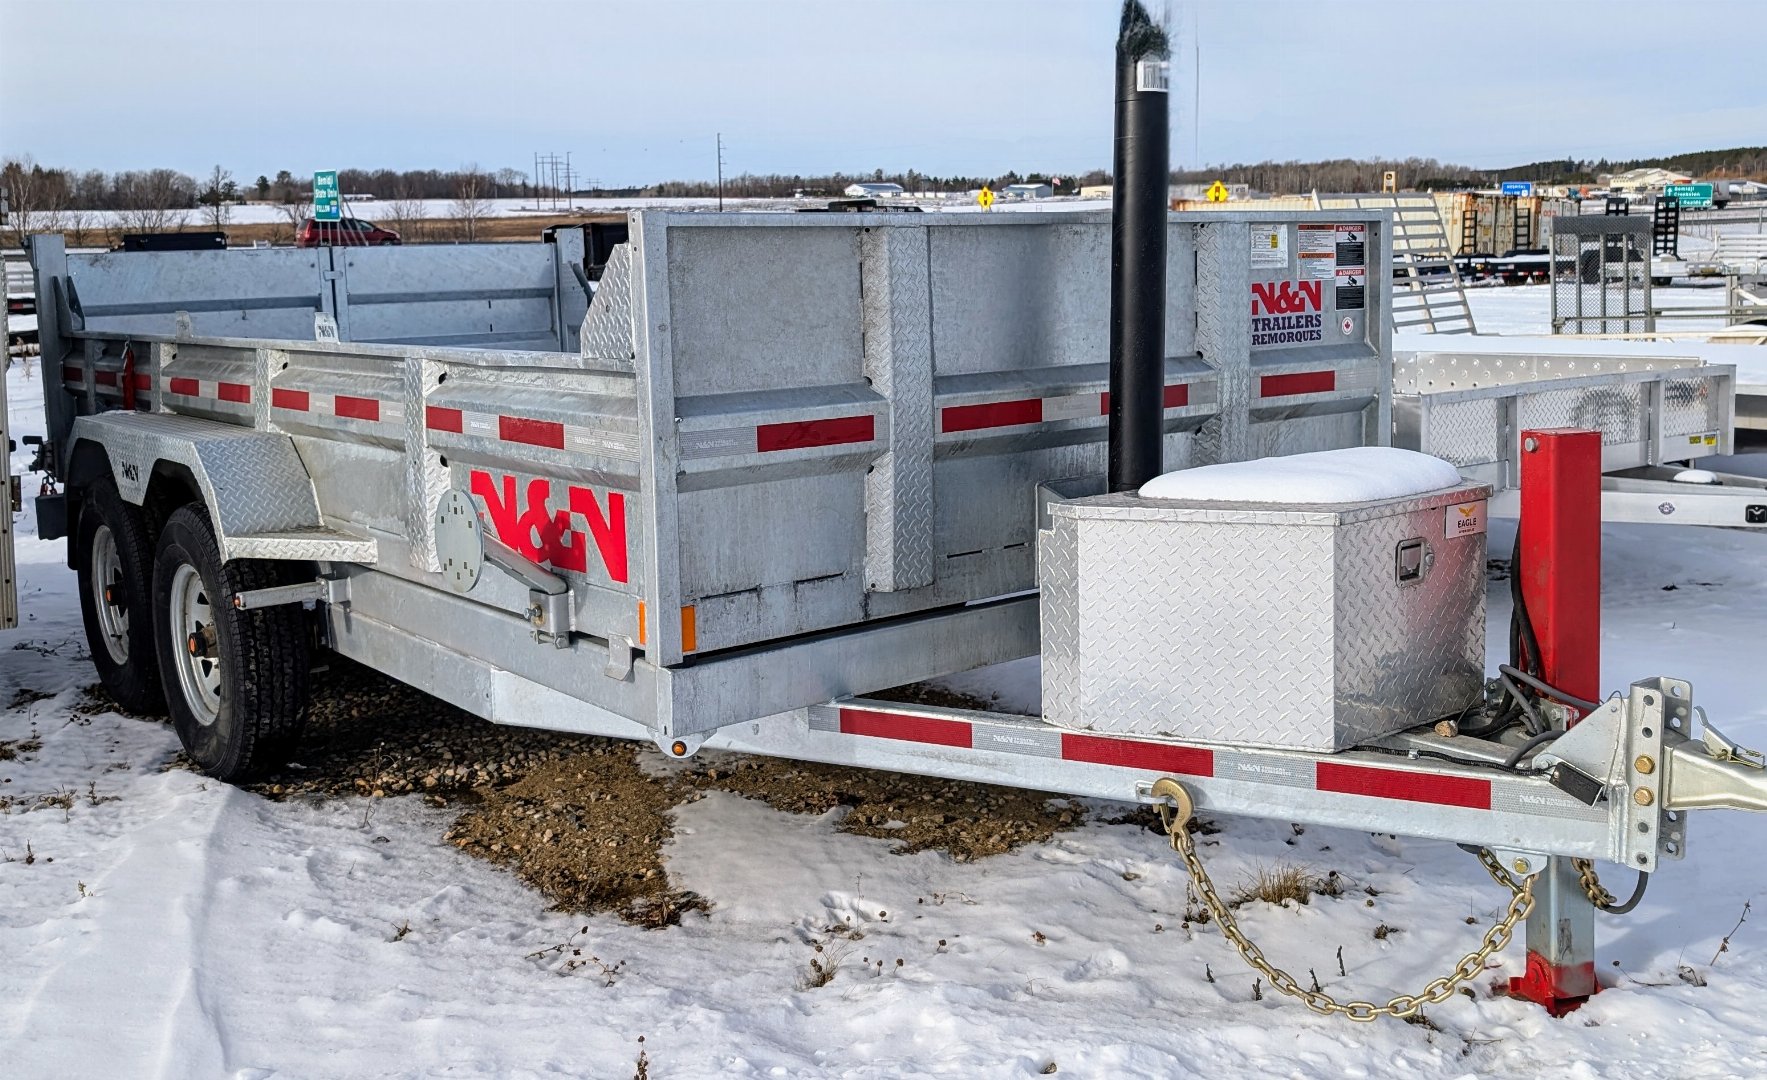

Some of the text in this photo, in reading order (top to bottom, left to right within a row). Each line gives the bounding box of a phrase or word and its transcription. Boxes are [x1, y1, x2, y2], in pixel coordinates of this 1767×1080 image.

[1251, 280, 1322, 316] N&N
[1251, 313, 1322, 333] TRAILERS
[1251, 329, 1322, 346] REMORQUES
[1457, 517, 1477, 529] EAGLE
